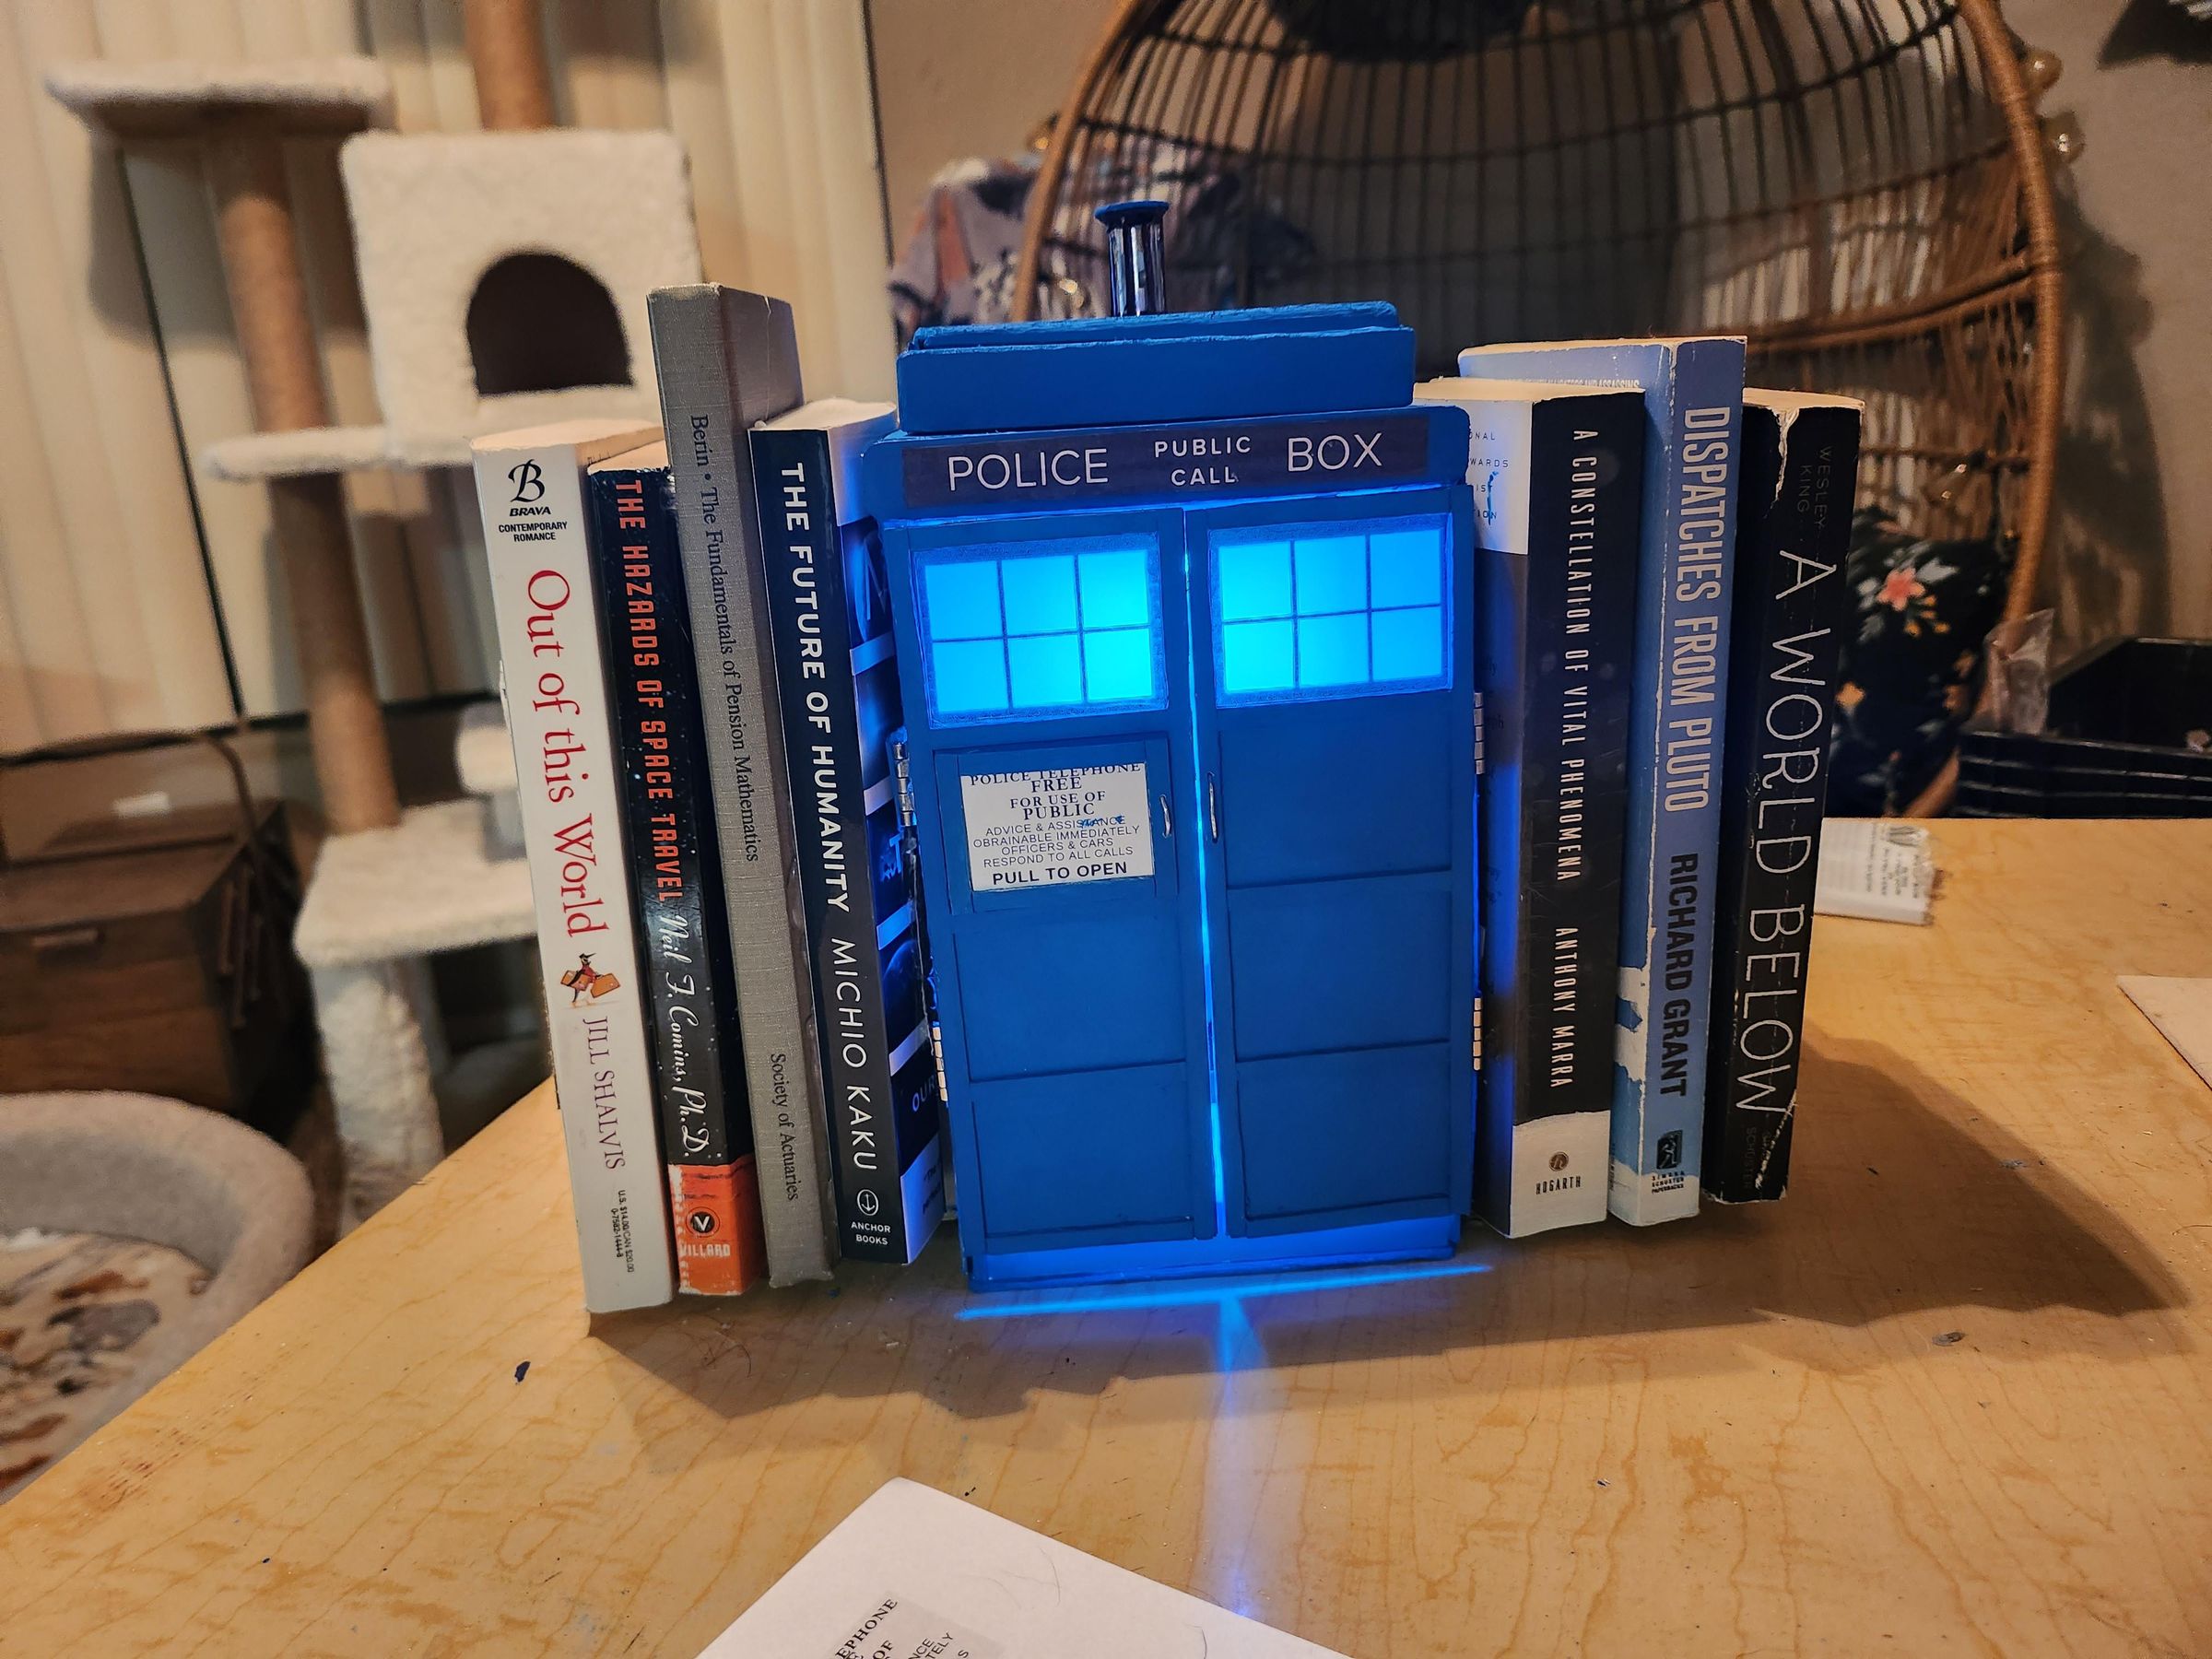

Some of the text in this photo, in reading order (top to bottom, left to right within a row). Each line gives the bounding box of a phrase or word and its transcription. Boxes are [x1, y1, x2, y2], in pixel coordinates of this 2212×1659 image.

[1154, 436, 1252, 458] PUBLIC
[1288, 432, 1382, 472] BOX
[508, 459, 545, 502] B
[947, 448, 1109, 491] POLICE
[1171, 466, 1237, 487] CALL
[1797, 465, 1813, 512] KING
[1814, 445, 1832, 528] WESLEY
[510, 506, 551, 516] BRAVA
[499, 521, 568, 533] CONTEMPORARY
[513, 532, 556, 542] ROMANCE
[1665, 406, 1731, 813] DISPATCHES FROM PLUTO
[691, 415, 759, 862] Berin The Fundamentals of Pension Mathematics
[1557, 429, 1598, 881] A CONSTELLATION OF VITAL PHENOMENA
[616, 479, 684, 902] THE HAZARDS OF SPACE TRAVEL
[782, 462, 850, 912] THE FUTURE OF HUMANITY
[526, 570, 609, 937] Out of this World
[971, 763, 1141, 785] POLICE TELEPHONE
[1031, 776, 1082, 794] FREE
[1010, 790, 1106, 808] FOR USE OF
[1023, 803, 1095, 820] PUBLIC
[973, 825, 1140, 848] OBRAINABLE IMMEDIATELY
[985, 823, 1031, 836] ADVICE
[1035, 822, 1043, 831] &
[1735, 550, 1837, 1113] A WORLD BELOW
[983, 847, 1134, 868] RESPOND TO ALL CALLS
[1001, 838, 1113, 855] OFFICERS & CARS
[993, 862, 1127, 885] PULL TO OPEN
[659, 914, 693, 964] Neil
[1659, 853, 1699, 1097] RICHARD GRANT
[1550, 927, 1579, 1088] ANTHONY MARRA
[668, 1006, 700, 1082] Comins,
[830, 937, 877, 1171] MICHIO KAKU
[582, 1016, 626, 1171] JILL SHALVIS
[771, 1053, 799, 1201] Society of Actuaries
[618, 1189, 627, 1205] U.S.
[1535, 1176, 1582, 1195] HOGARTH
[694, 1216, 711, 1231] V
[851, 1221, 891, 1234] ANCHOR
[678, 1243, 731, 1257] VILLARD
[855, 1233, 888, 1246] BOOKS
